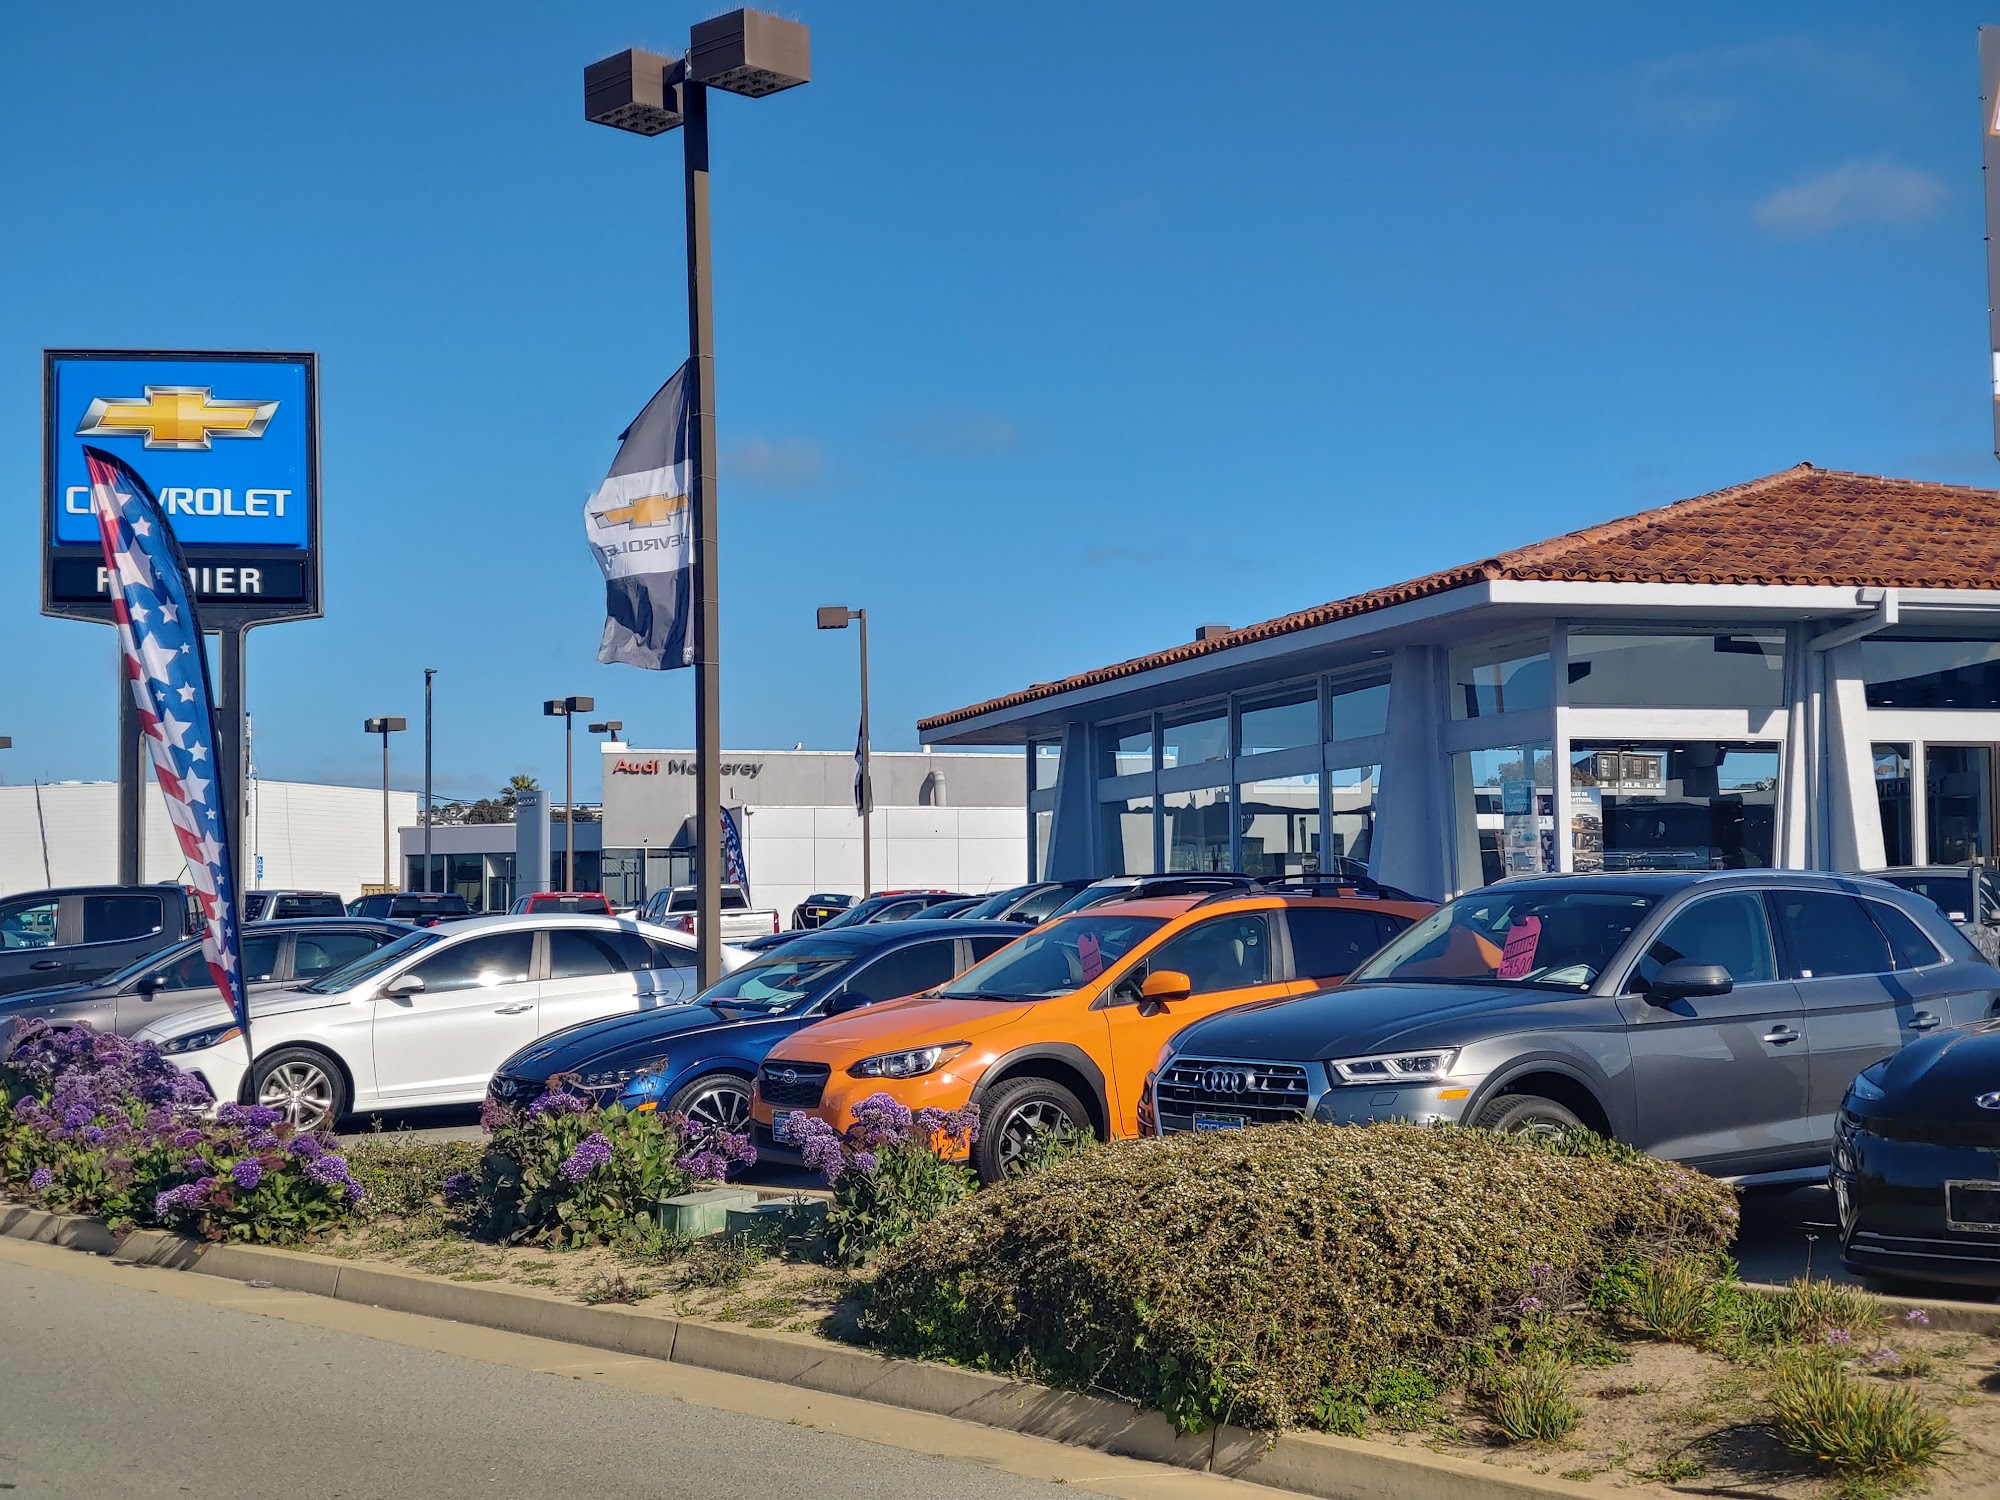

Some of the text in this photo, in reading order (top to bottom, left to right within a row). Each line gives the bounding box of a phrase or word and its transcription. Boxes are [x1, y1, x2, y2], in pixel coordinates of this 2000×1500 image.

[65, 486, 293, 517] CROLET
[96, 566, 261, 594] PIER
[613, 758, 763, 779] Audi Moerey
[722, 919, 769, 927] VROLET
